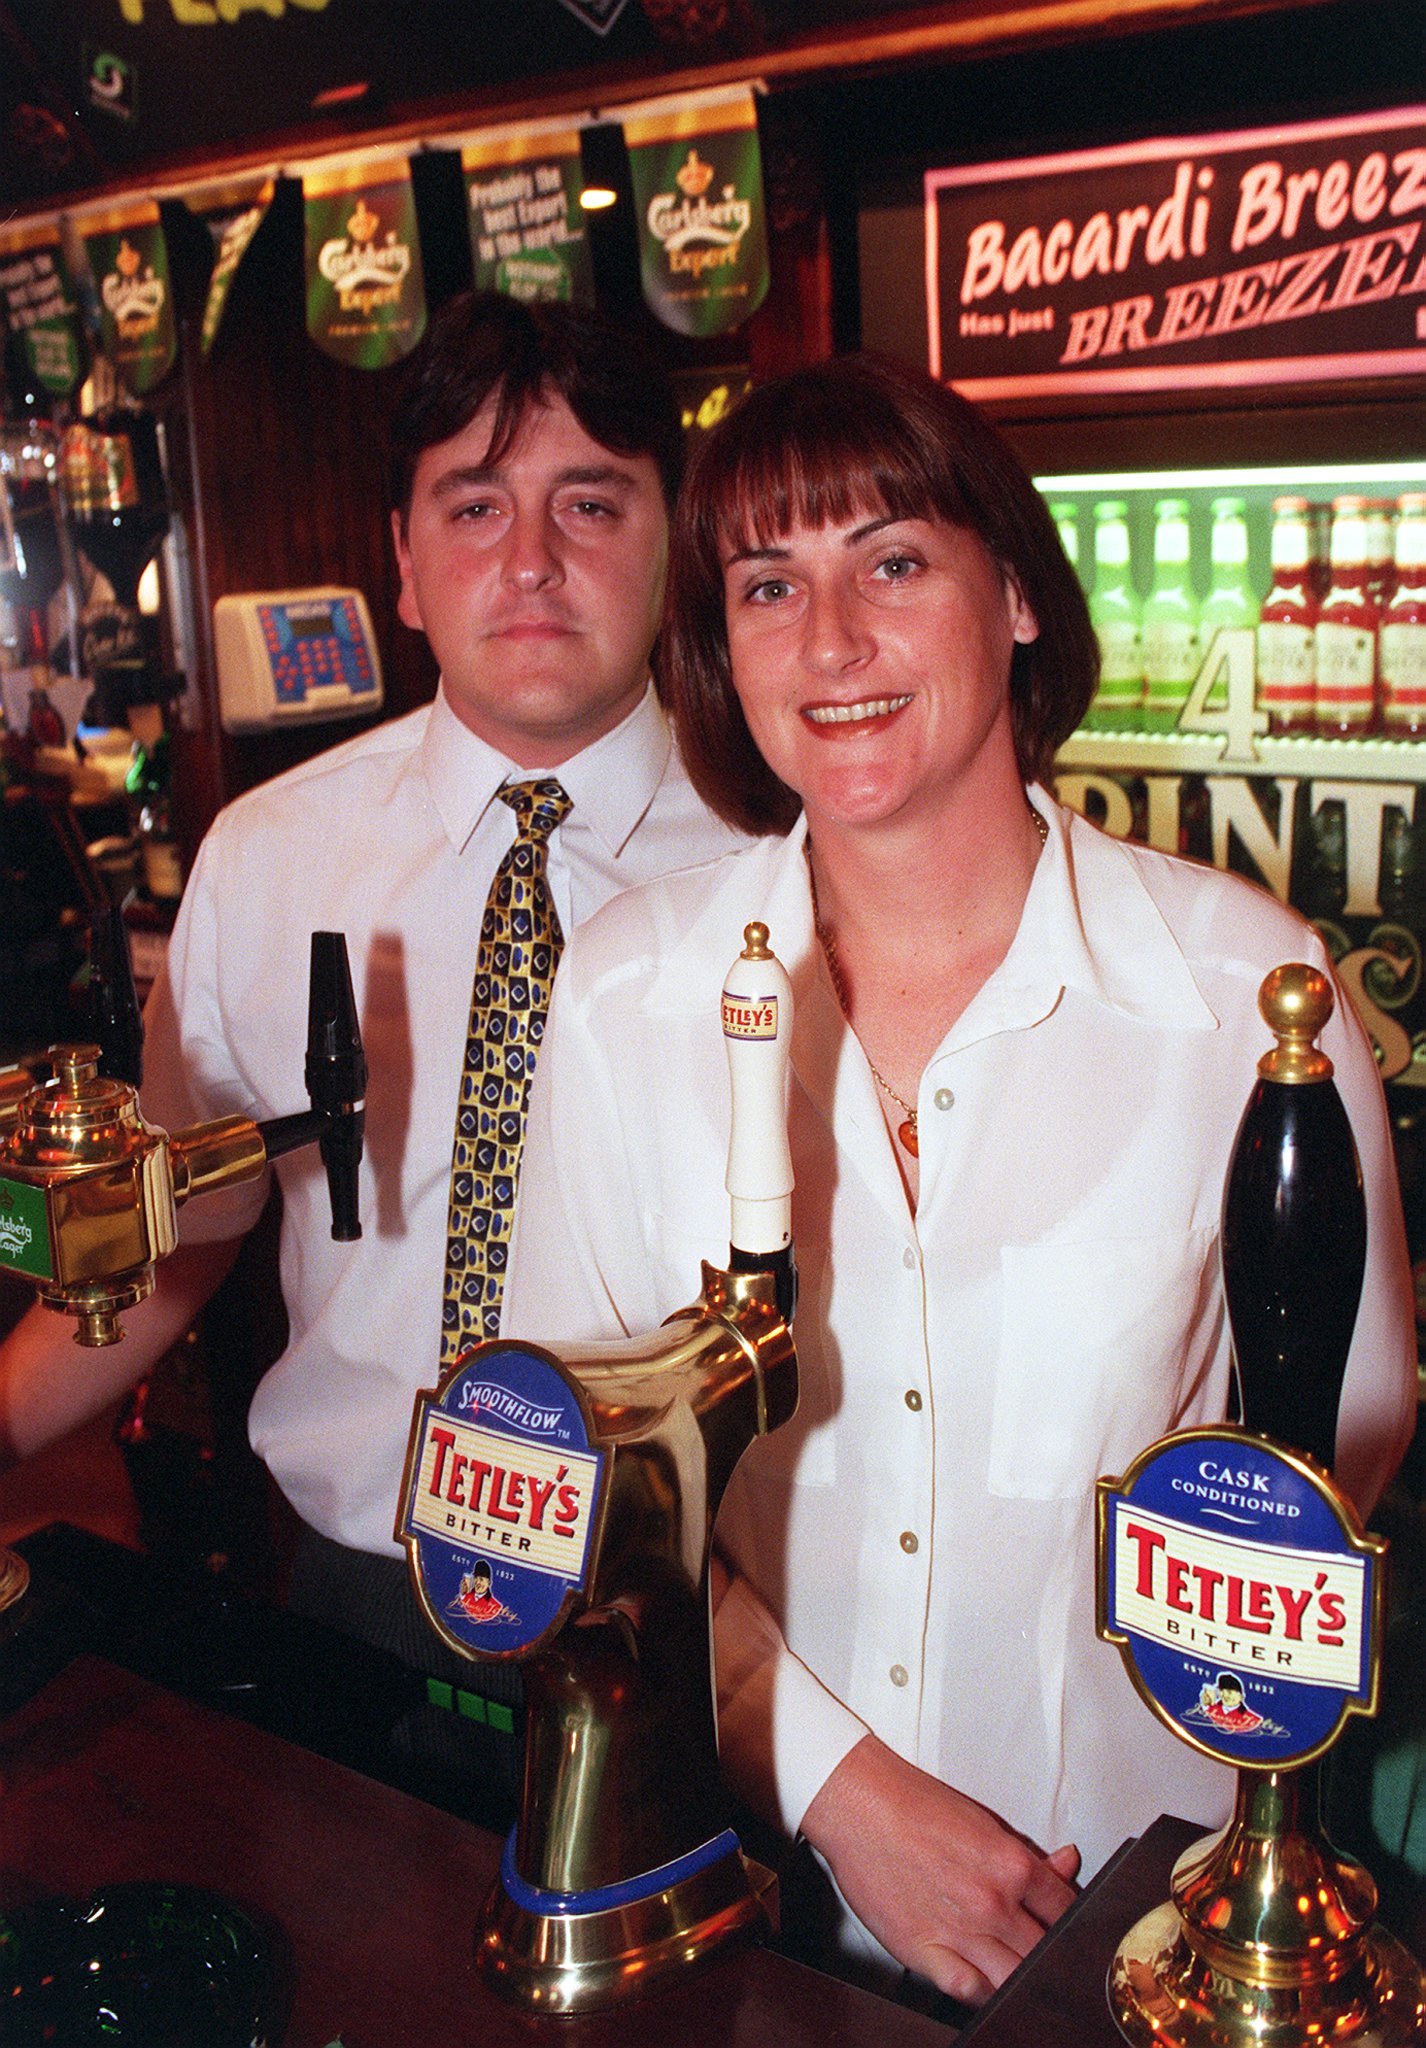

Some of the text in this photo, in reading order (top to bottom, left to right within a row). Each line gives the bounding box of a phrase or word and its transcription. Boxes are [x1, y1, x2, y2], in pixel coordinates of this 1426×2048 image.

[647, 183, 751, 250] Carlsberg
[960, 161, 1213, 305] Bacardi
[669, 240, 740, 278] Export
[1059, 221, 1426, 364] BREEZE
[1178, 628, 1270, 763] 4
[721, 1002, 773, 1026] ETLEY'S
[458, 1380, 563, 1430] SMOOTHFLOW
[430, 1426, 580, 1539] TETLEY'S
[1171, 1478, 1301, 1518] CONDITIONED
[1199, 1461, 1271, 1494] CASK
[446, 1514, 532, 1552] BITTER
[1126, 1522, 1347, 1647] TETLEY'S
[1167, 1618, 1293, 1666] BITTER
